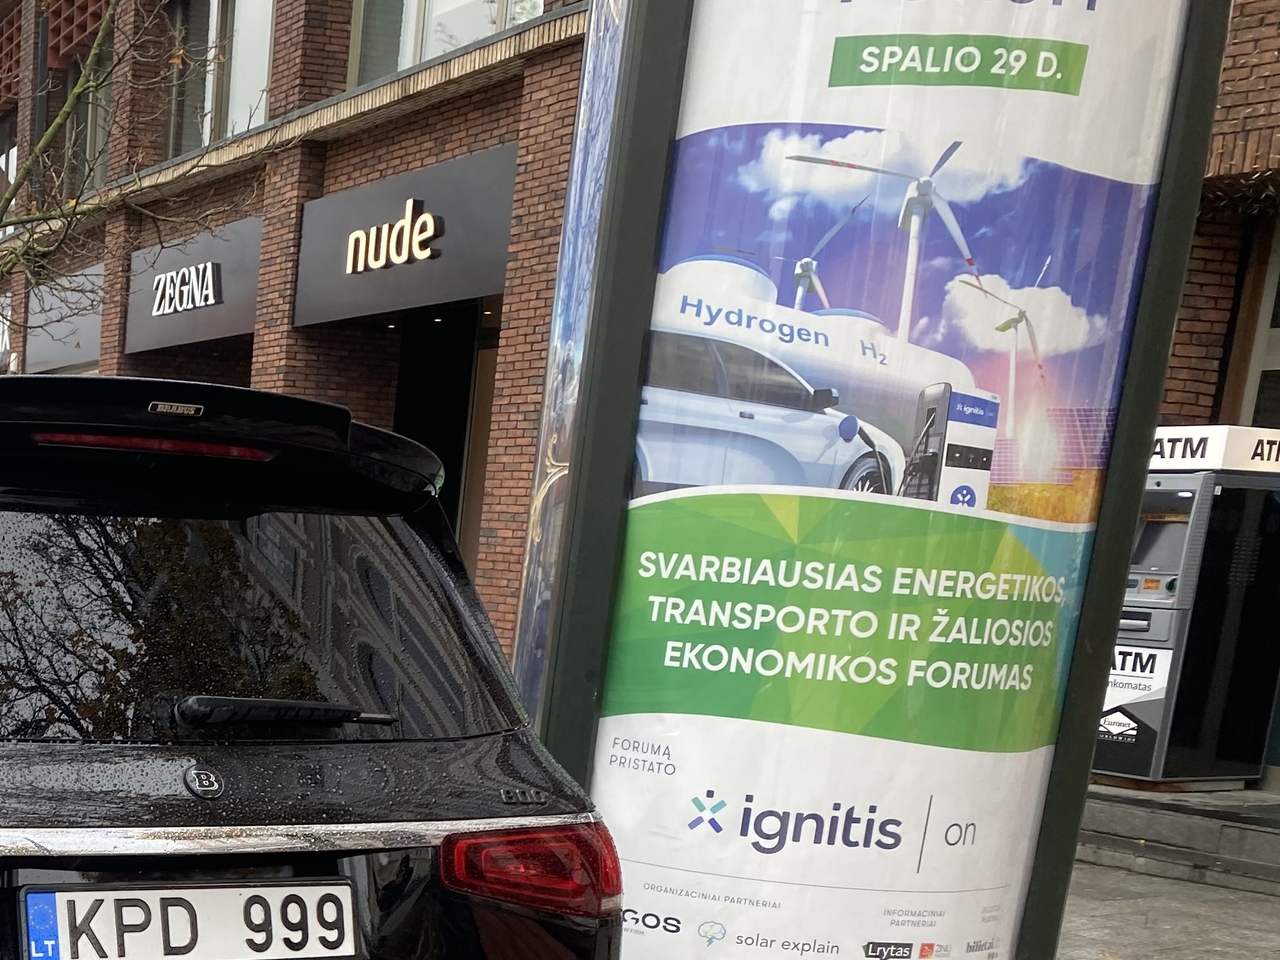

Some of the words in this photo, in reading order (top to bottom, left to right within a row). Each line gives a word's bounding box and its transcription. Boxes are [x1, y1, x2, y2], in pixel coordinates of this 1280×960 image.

[859, 46, 982, 73] SPALIO
[990, 48, 1027, 76] 29
[1036, 51, 1062, 80] D.
[346, 198, 435, 274] nude
[152, 261, 216, 316] ZEGNA
[679, 295, 830, 347] Hydrogen
[157, 404, 196, 414] BRABUS
[1152, 437, 1209, 459] ATM
[1251, 439, 1280, 462] AT
[638, 551, 883, 593] SVARBIAUSIAS
[648, 595, 878, 638] TRANSPORTO
[887, 613, 920, 641] IR
[928, 609, 1052, 647] ŽALIOSIOS
[663, 640, 897, 686] EKONOMIKOS
[907, 659, 1033, 691] FORUMAS
[1112, 650, 1157, 673] TM
[1109, 680, 1152, 692] nkomatas
[612, 737, 672, 760] FORUMĄ
[609, 754, 676, 776] PRISTATO
[192, 770, 218, 790] B
[739, 794, 903, 854] ignitis
[944, 822, 976, 846] on
[643, 882, 721, 902] ORGANIZACINIAI
[724, 895, 781, 910] PARTNERIAI
[622, 908, 681, 933] GOS
[883, 908, 945, 918] INFORMACINIAI
[890, 919, 937, 928] PARTNERIAI
[67, 897, 198, 960] KPD
[243, 893, 345, 953] 999
[31, 940, 57, 957] LT
[735, 933, 776, 949] solar
[781, 939, 840, 956] explain
[868, 943, 911, 959] Lrytas
